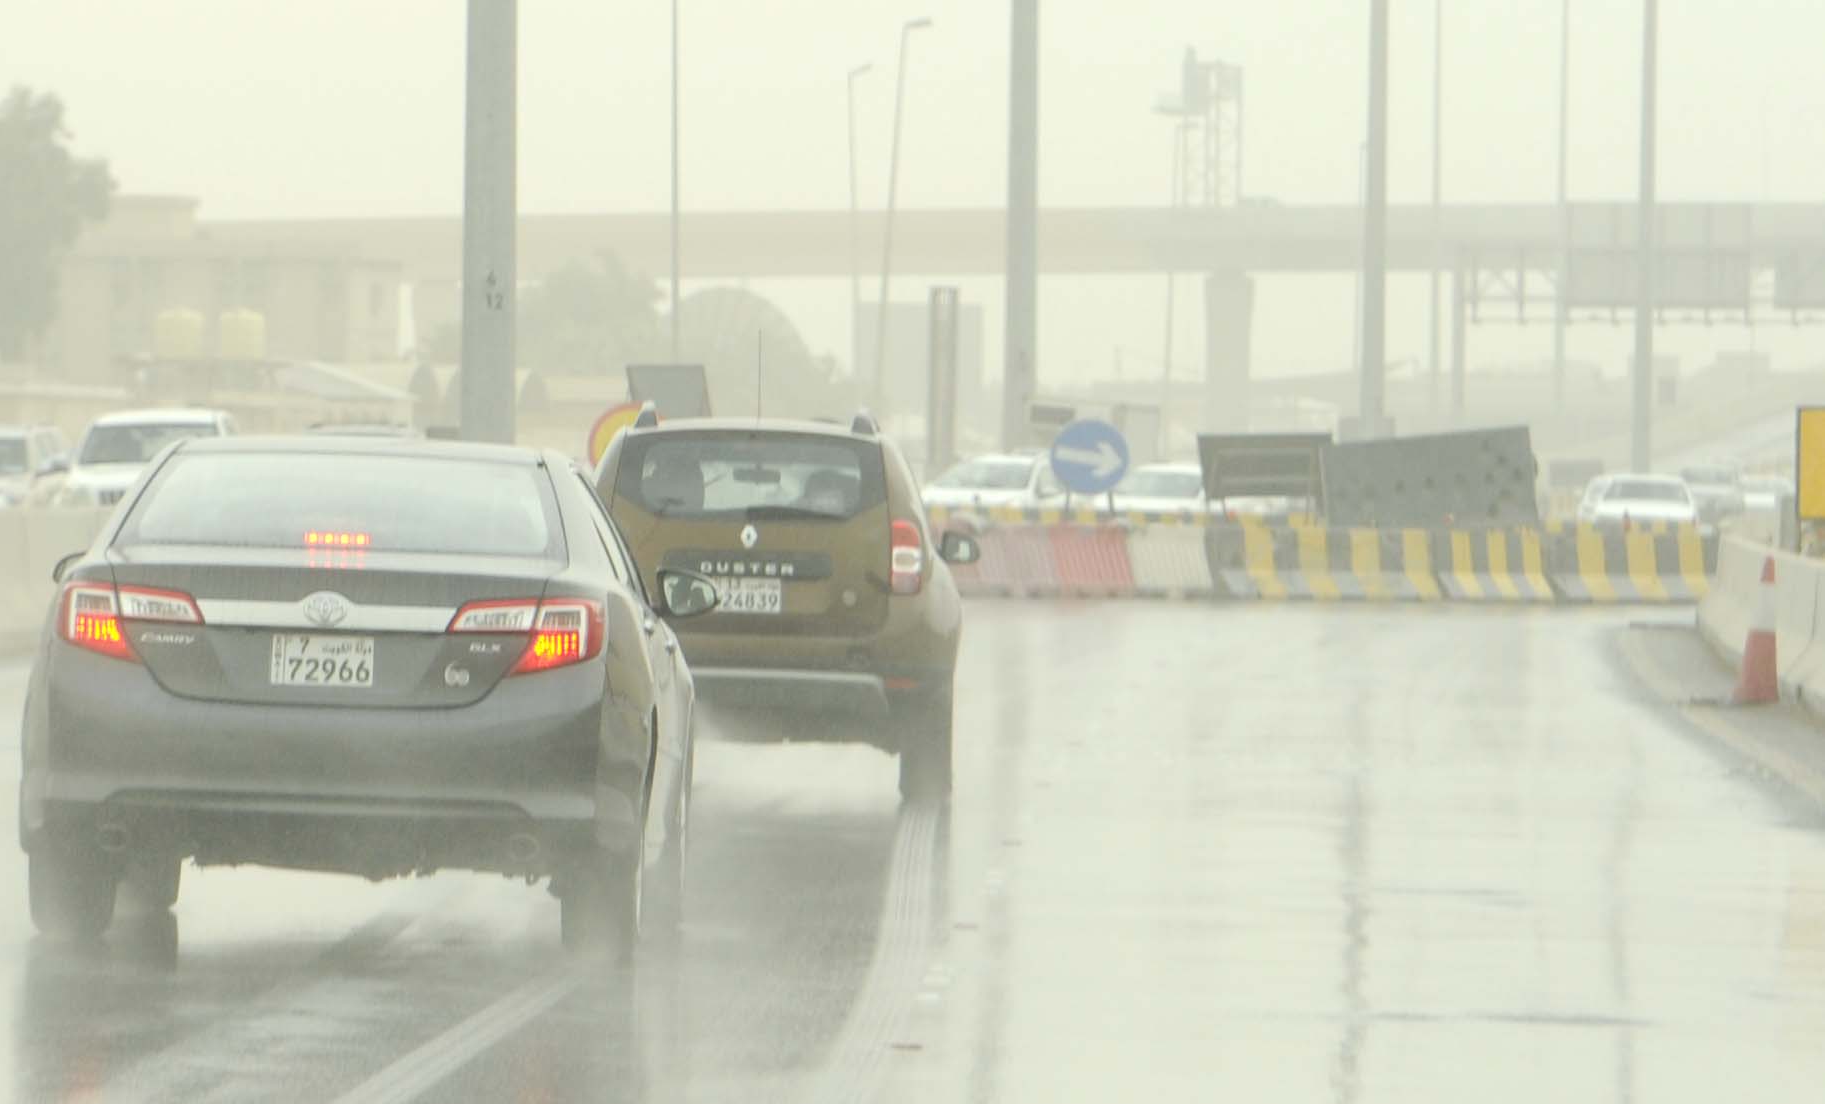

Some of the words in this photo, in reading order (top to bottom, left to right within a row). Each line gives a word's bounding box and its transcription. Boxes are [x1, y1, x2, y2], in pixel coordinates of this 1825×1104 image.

[700, 561, 794, 576] DUSTER
[299, 638, 310, 655] 7
[288, 658, 370, 682] 72966
